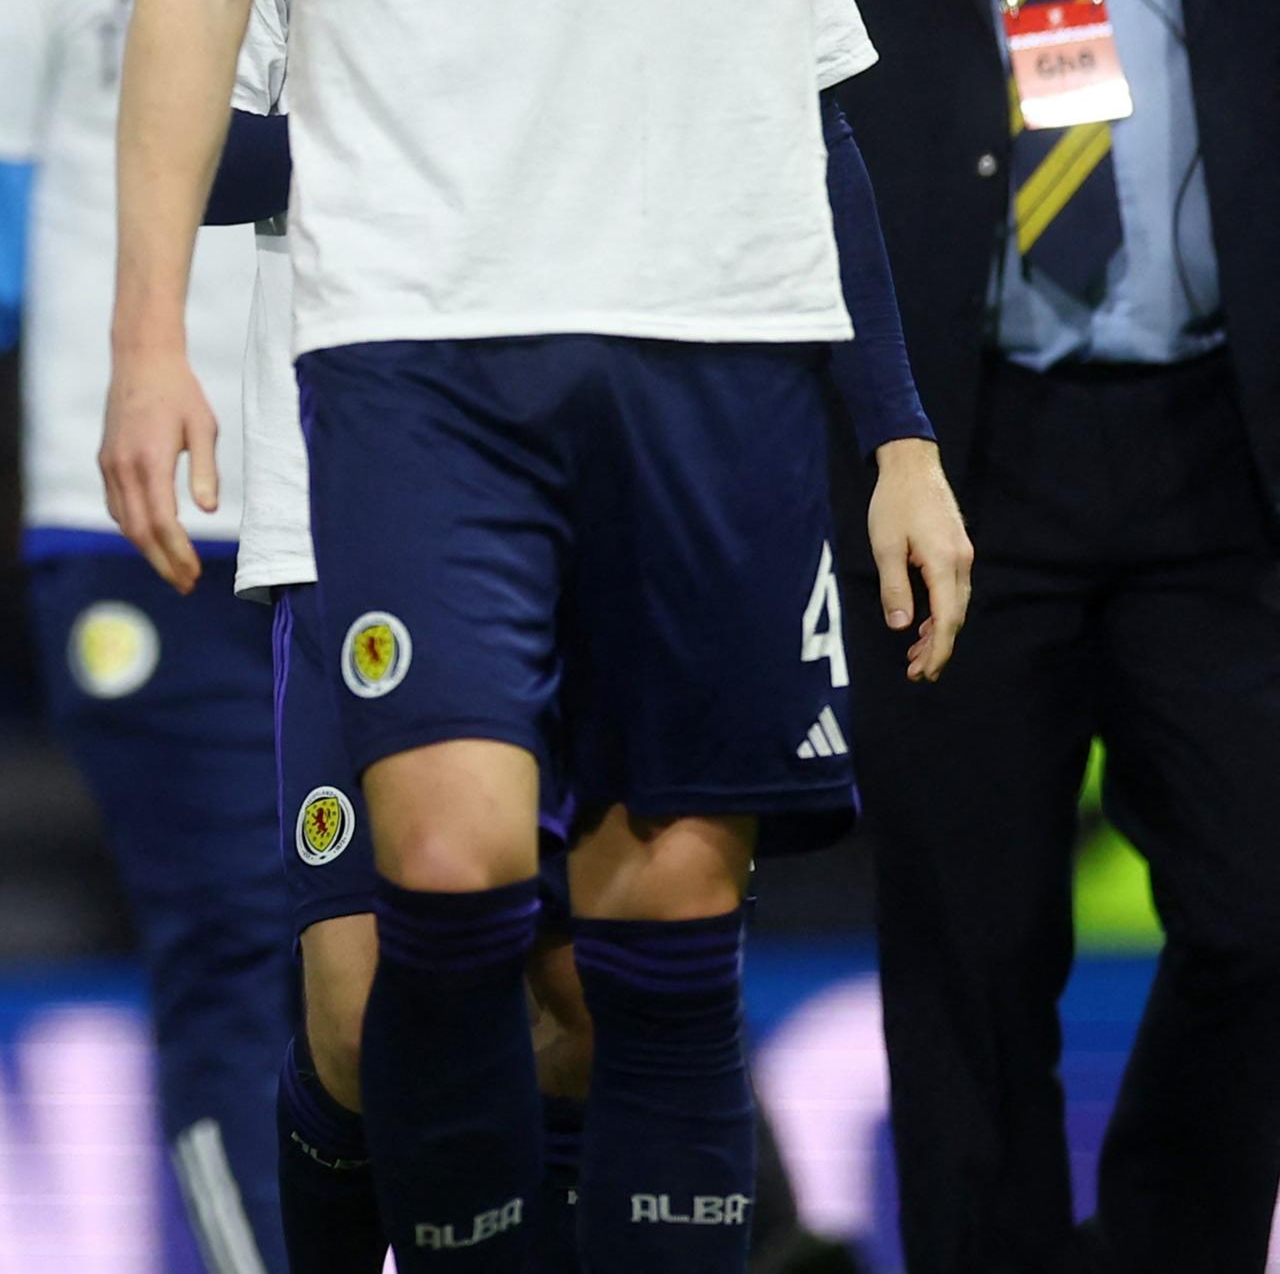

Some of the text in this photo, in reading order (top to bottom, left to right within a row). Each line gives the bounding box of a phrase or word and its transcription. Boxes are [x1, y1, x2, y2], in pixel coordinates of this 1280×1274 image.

[801, 539, 850, 688] 4
[415, 1197, 523, 1251] ALBA
[631, 1193, 751, 1225] ALBA
